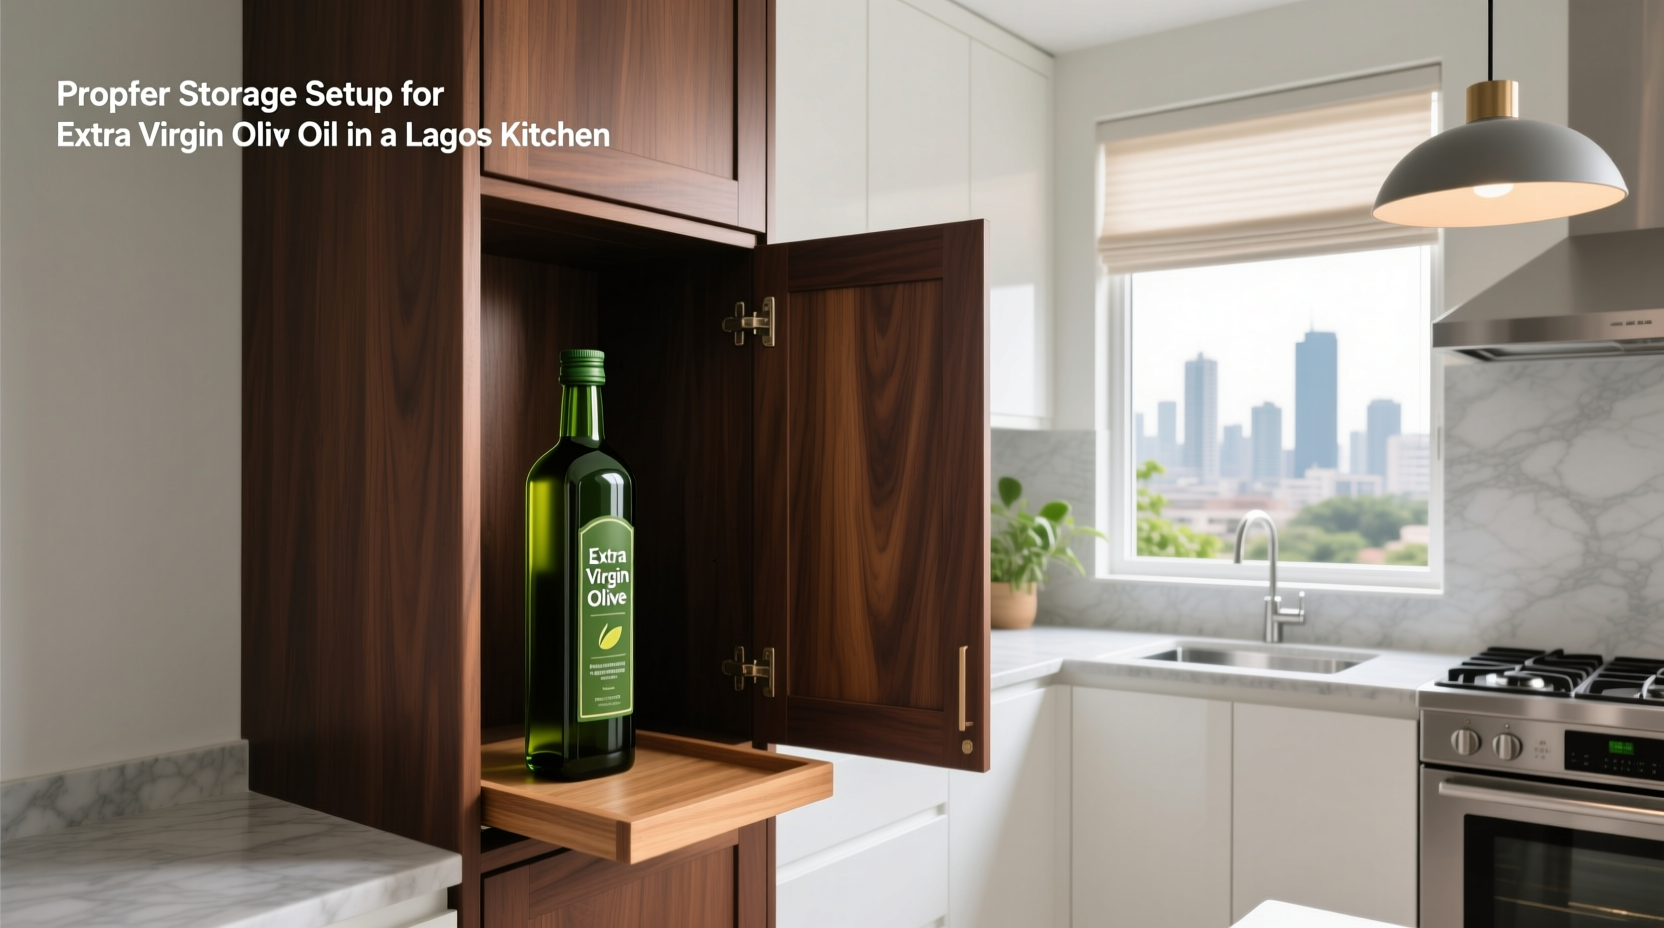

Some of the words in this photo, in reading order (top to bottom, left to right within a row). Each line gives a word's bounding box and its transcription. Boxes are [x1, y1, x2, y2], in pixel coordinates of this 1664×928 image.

[589, 547, 627, 565] Extra
[585, 567, 630, 589] Virgin
[587, 588, 627, 607] Olive
